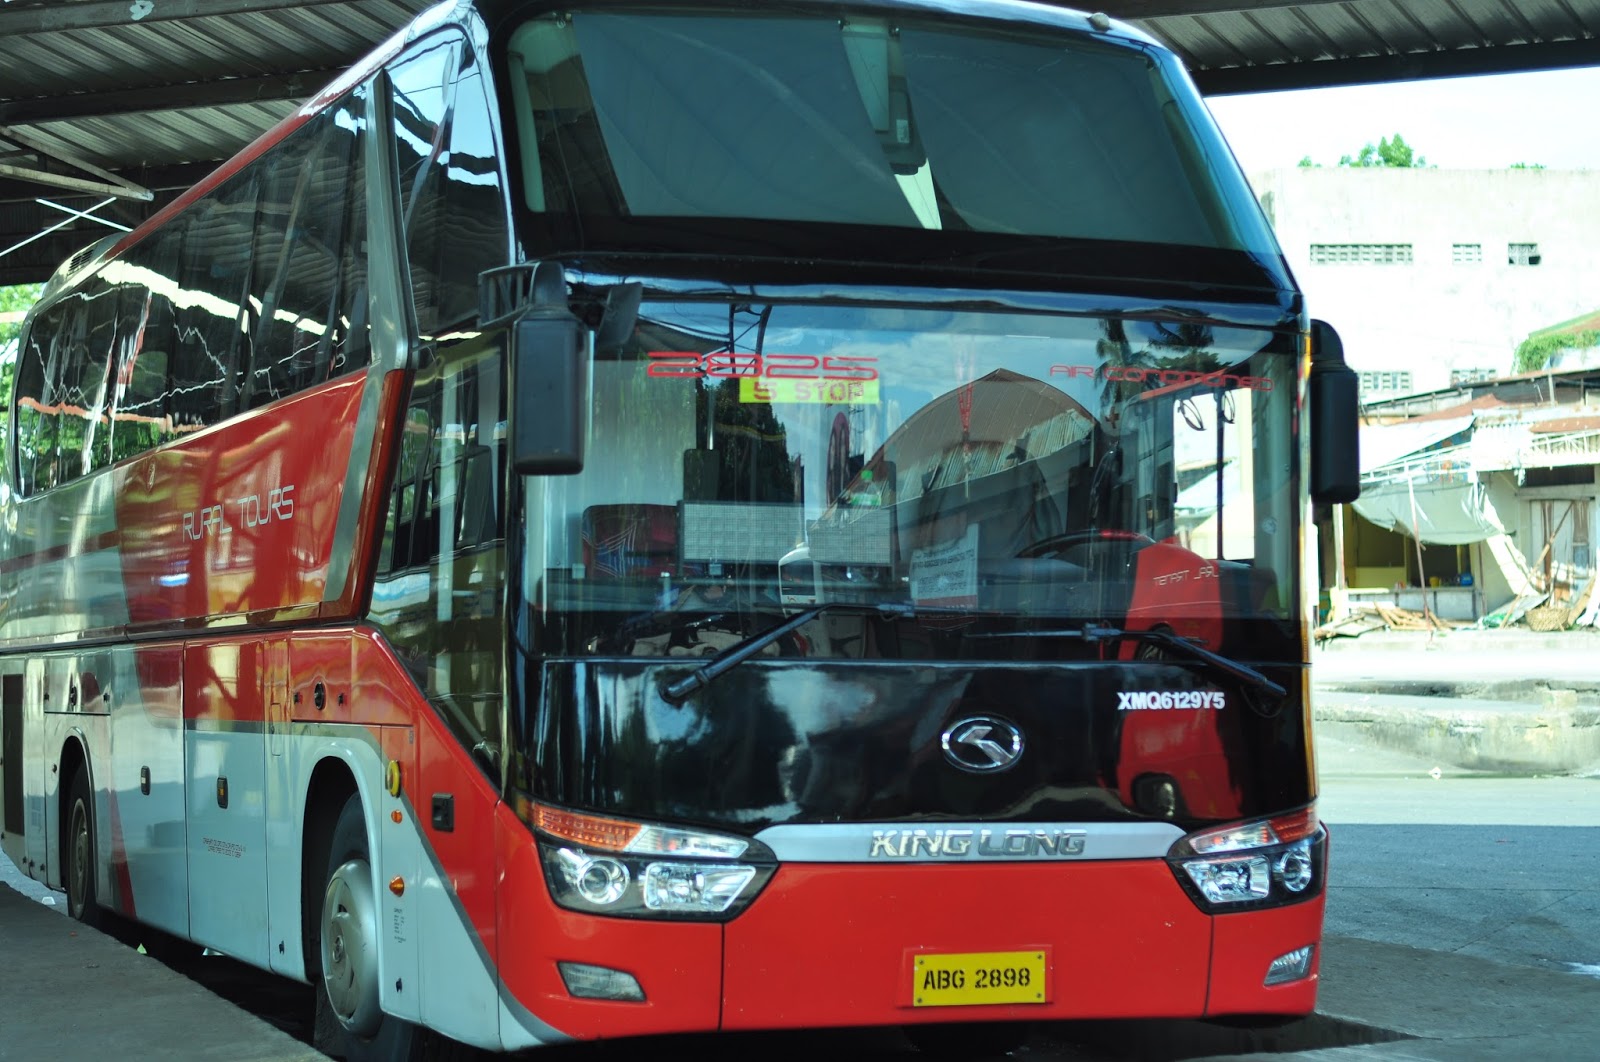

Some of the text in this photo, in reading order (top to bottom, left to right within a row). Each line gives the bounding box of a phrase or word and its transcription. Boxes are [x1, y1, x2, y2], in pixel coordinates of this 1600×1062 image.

[647, 352, 879, 381] 2825
[1050, 364, 1095, 379] AIR
[753, 381, 865, 402] 5 STOP
[182, 484, 295, 543] RURAL TOURS
[1116, 691, 1226, 710] XMQ6129Y5
[869, 829, 1088, 857] KING LONG
[923, 967, 1031, 990] ABG 2898
